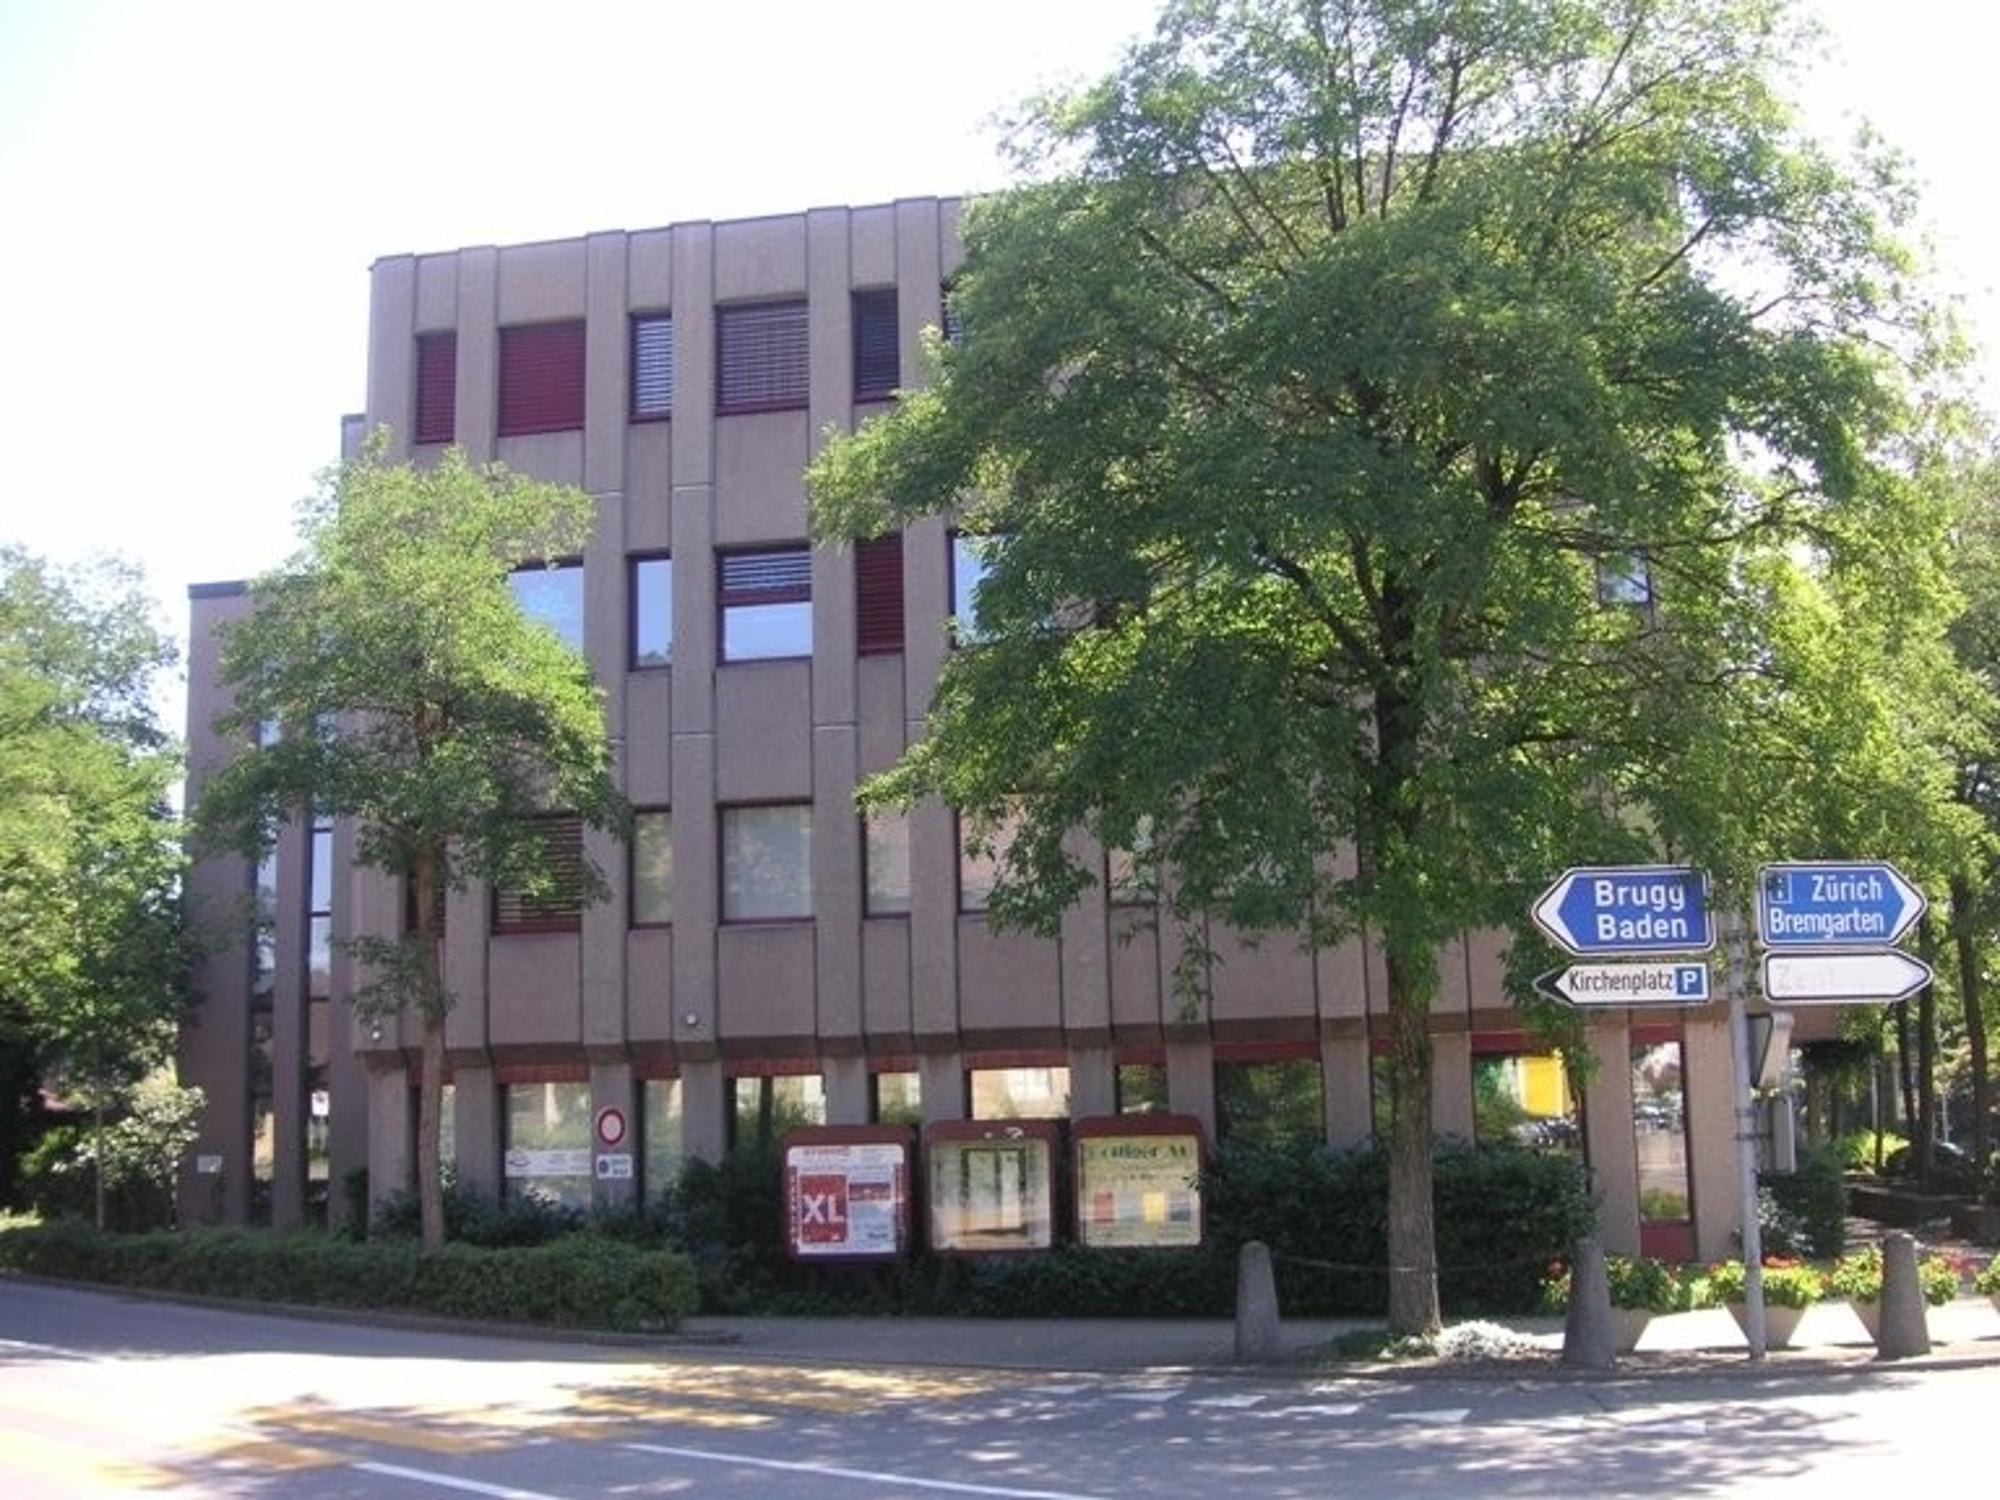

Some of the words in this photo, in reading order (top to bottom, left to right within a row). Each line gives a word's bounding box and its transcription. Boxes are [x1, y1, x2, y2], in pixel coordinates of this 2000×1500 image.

[1811, 873, 1882, 902] Zürich
[1597, 913, 1688, 941] Baden
[1769, 908, 1884, 939] Bremgarten
[1569, 968, 1673, 994] Kirchenplatz
[1682, 973, 1697, 991] P
[804, 1194, 845, 1223] XL
